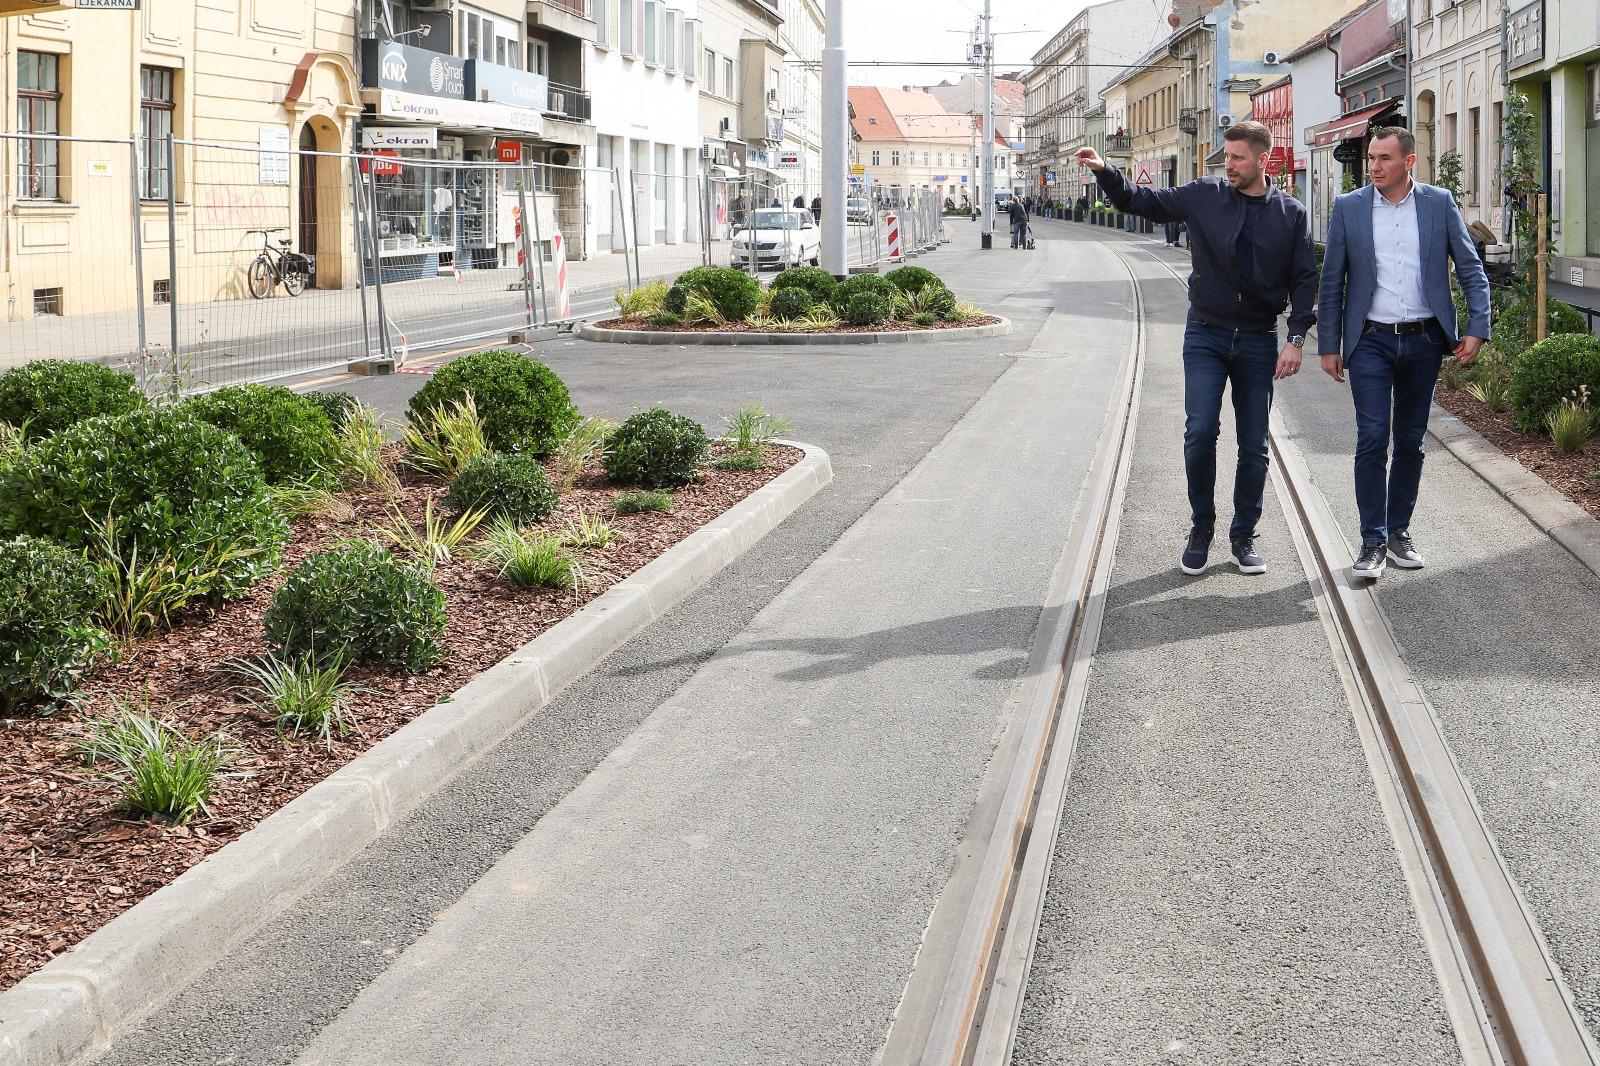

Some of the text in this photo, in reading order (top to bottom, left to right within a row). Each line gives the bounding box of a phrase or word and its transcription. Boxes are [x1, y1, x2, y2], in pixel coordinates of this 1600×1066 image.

[382, 61, 408, 84] KNX
[443, 61, 464, 80] Smart
[444, 77, 464, 94] Touch
[403, 104, 438, 116] ekran
[386, 136, 428, 145] ekran
